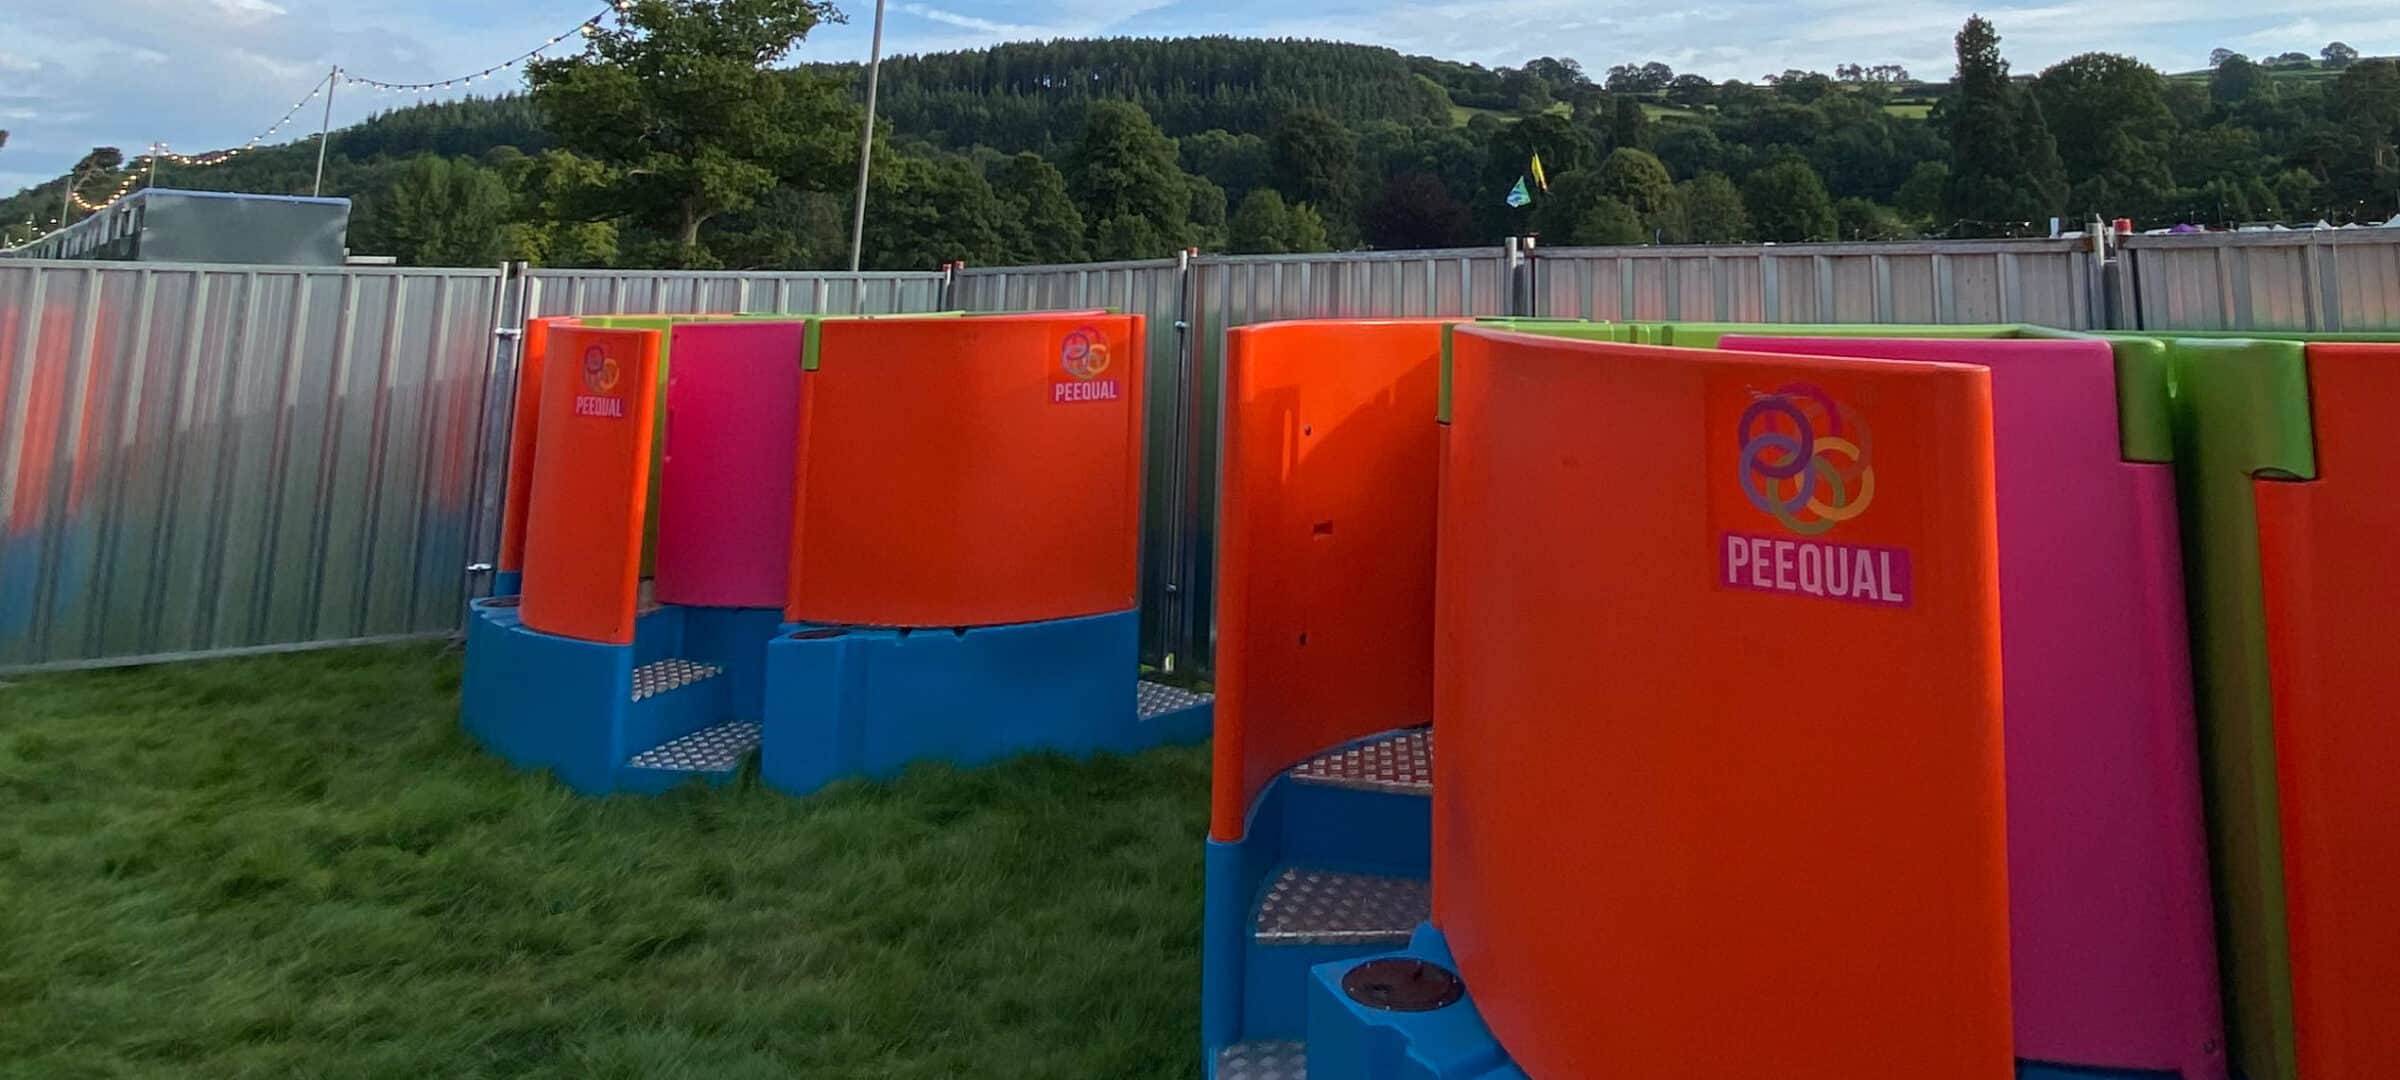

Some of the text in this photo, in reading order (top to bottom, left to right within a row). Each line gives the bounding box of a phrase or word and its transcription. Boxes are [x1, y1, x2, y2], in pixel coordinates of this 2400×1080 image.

[1054, 381, 1118, 402] PEEQUAL
[575, 395, 623, 417] PEEQUAL
[1727, 535, 1904, 603] PEEQUAL
